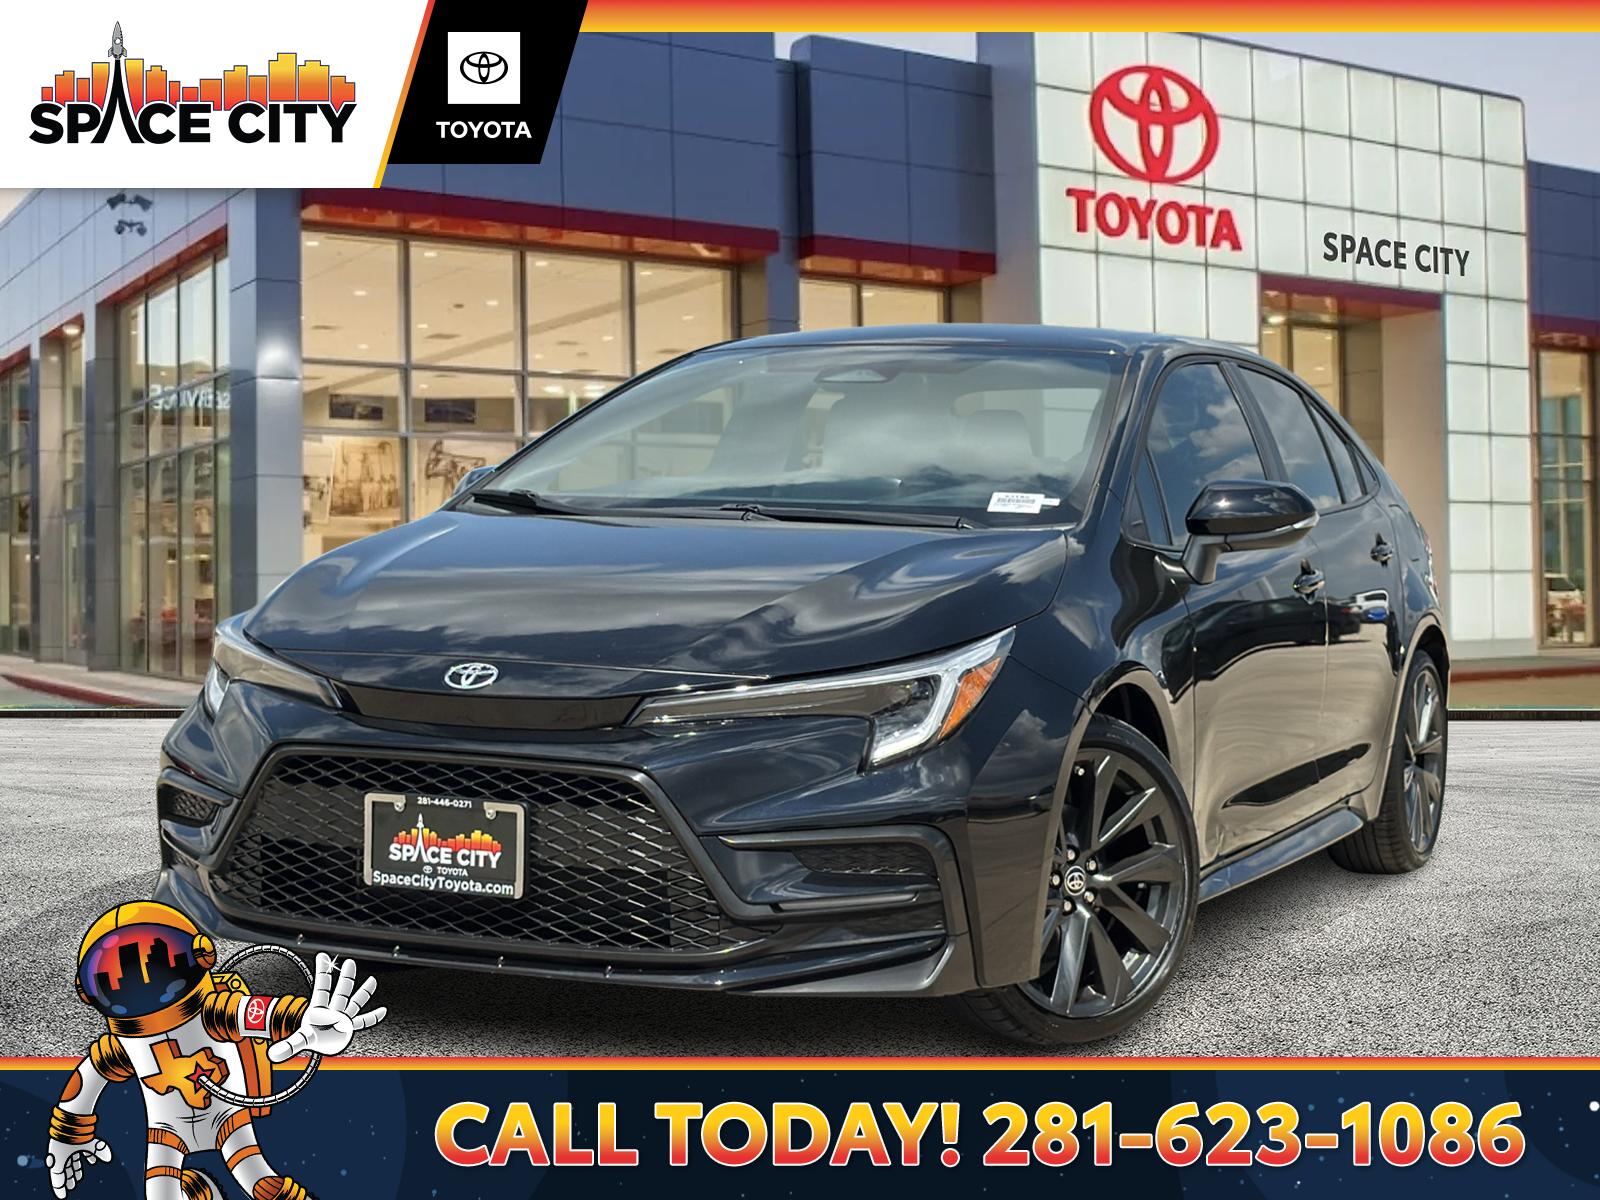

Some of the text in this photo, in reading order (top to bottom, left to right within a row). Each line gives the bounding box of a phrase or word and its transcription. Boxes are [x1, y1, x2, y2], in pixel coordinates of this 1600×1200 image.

[1066, 187, 1243, 251] TOYOTA
[1322, 231, 1470, 277] SPACE CITY
[457, 850, 502, 868] CITY
[373, 871, 514, 895] SpaceCityToyota.com
[437, 866, 469, 877] TOYOTA
